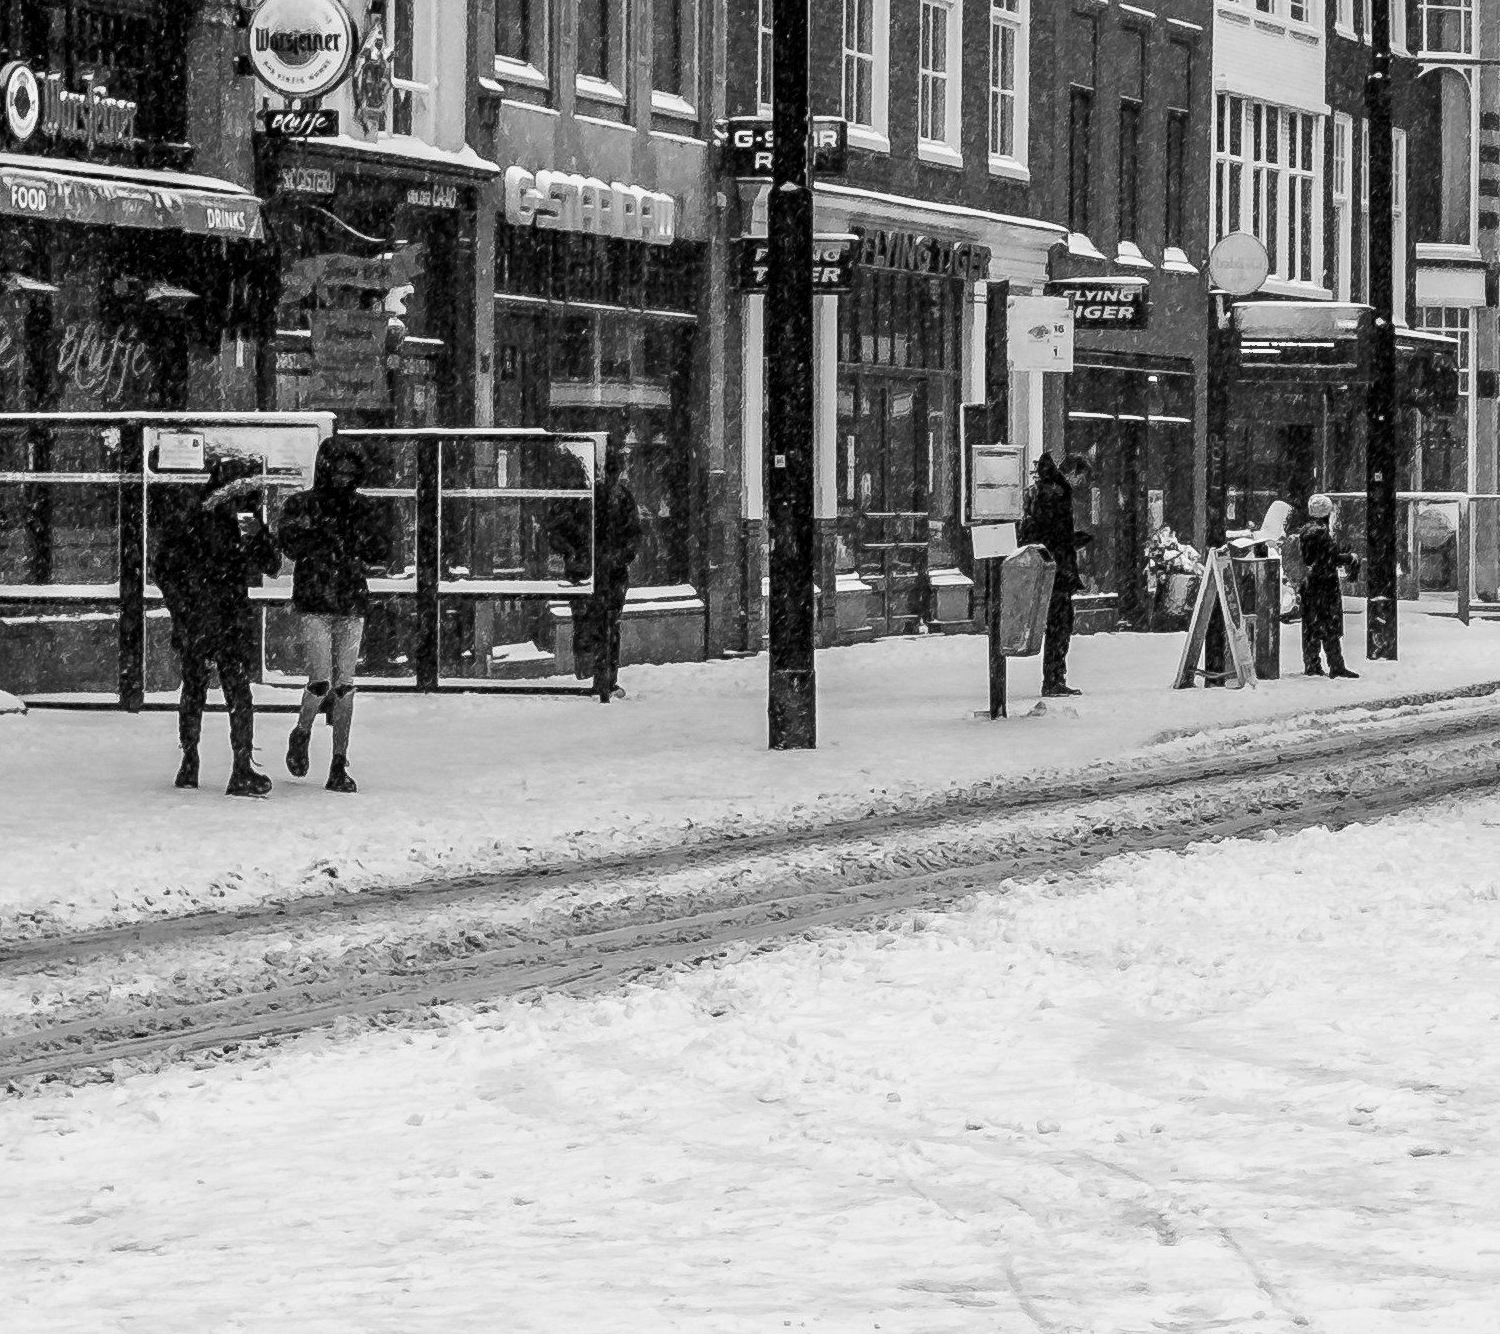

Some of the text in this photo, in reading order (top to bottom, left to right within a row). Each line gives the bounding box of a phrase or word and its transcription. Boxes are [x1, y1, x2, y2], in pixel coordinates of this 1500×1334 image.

[11, 185, 47, 212] FOOD
[206, 207, 247, 231] DRINKS
[1075, 305, 1135, 319] IGER
